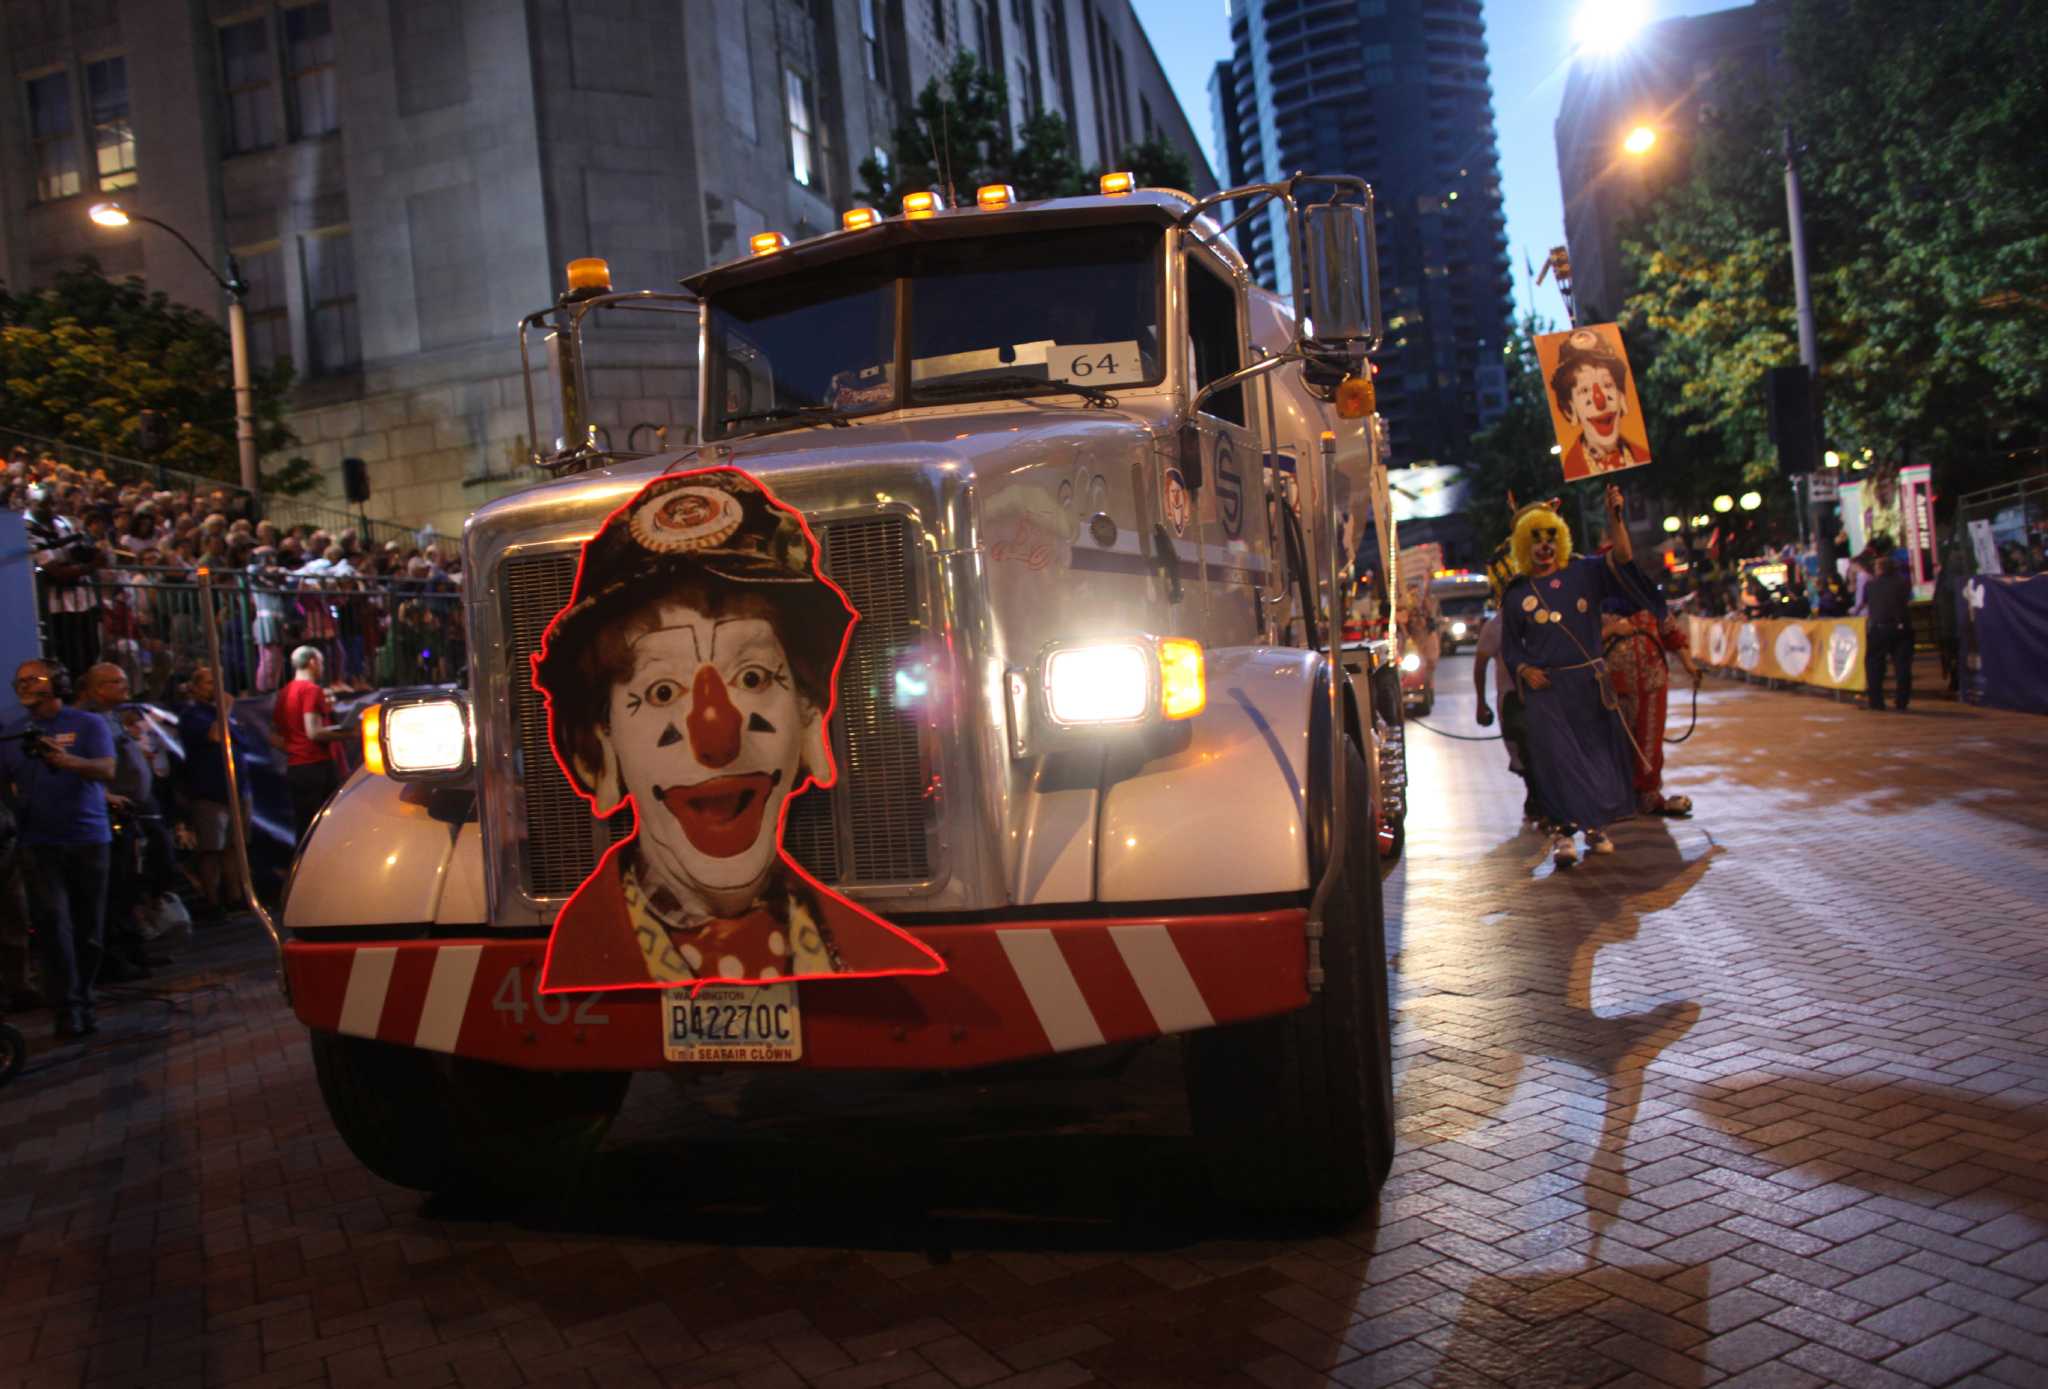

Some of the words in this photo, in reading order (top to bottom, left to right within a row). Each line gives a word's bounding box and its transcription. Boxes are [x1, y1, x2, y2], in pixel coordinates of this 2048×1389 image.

[1071, 353, 1119, 377] 64
[672, 991, 745, 1001] WAHINGTON
[672, 1004, 790, 1039] B42270C
[698, 1048, 746, 1060] SEAFAIR
[750, 1047, 792, 1060] CLOWN
